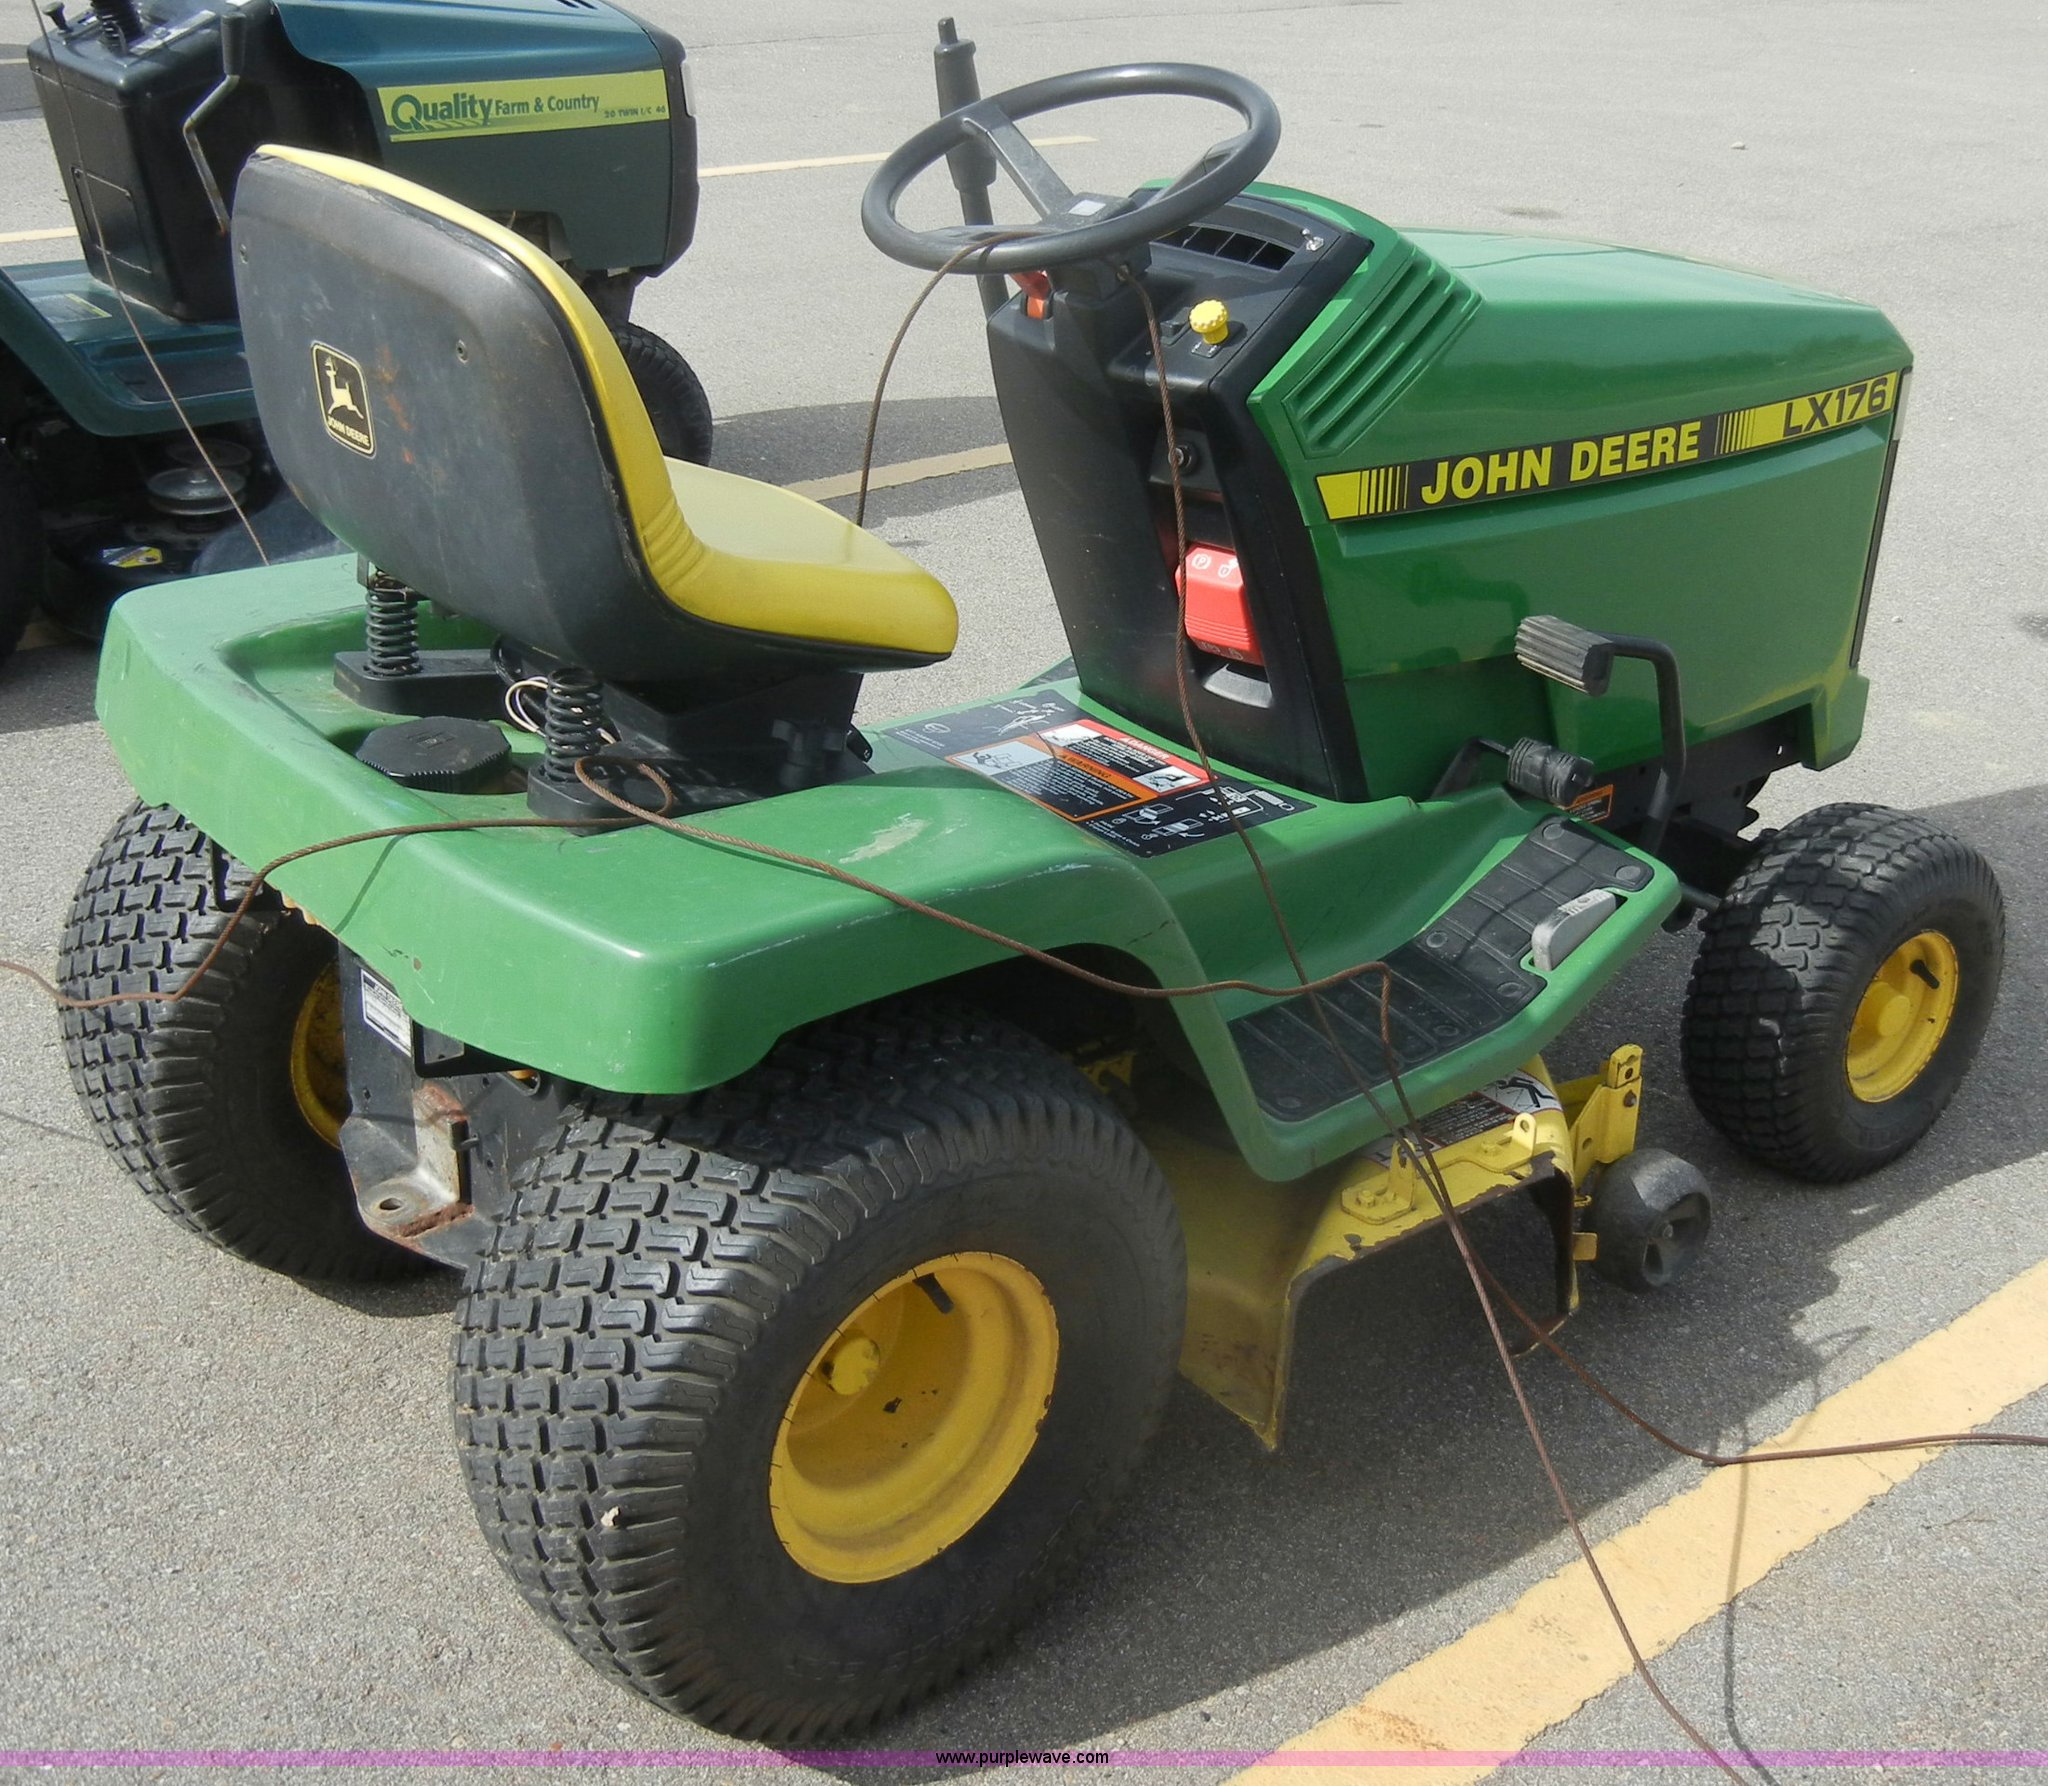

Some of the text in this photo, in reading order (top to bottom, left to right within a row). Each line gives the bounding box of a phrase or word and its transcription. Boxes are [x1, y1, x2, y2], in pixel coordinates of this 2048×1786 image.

[391, 92, 600, 130] Quality Farm & Country
[604, 109, 616, 118] 20
[618, 107, 639, 118] TWIN
[1782, 375, 1888, 437] LX176
[327, 415, 370, 447] JOHN DEERE
[1420, 421, 1702, 505] JOHN DEERE
[1128, 737, 1170, 760] DANGER
[1067, 756, 1112, 779] WARNING
